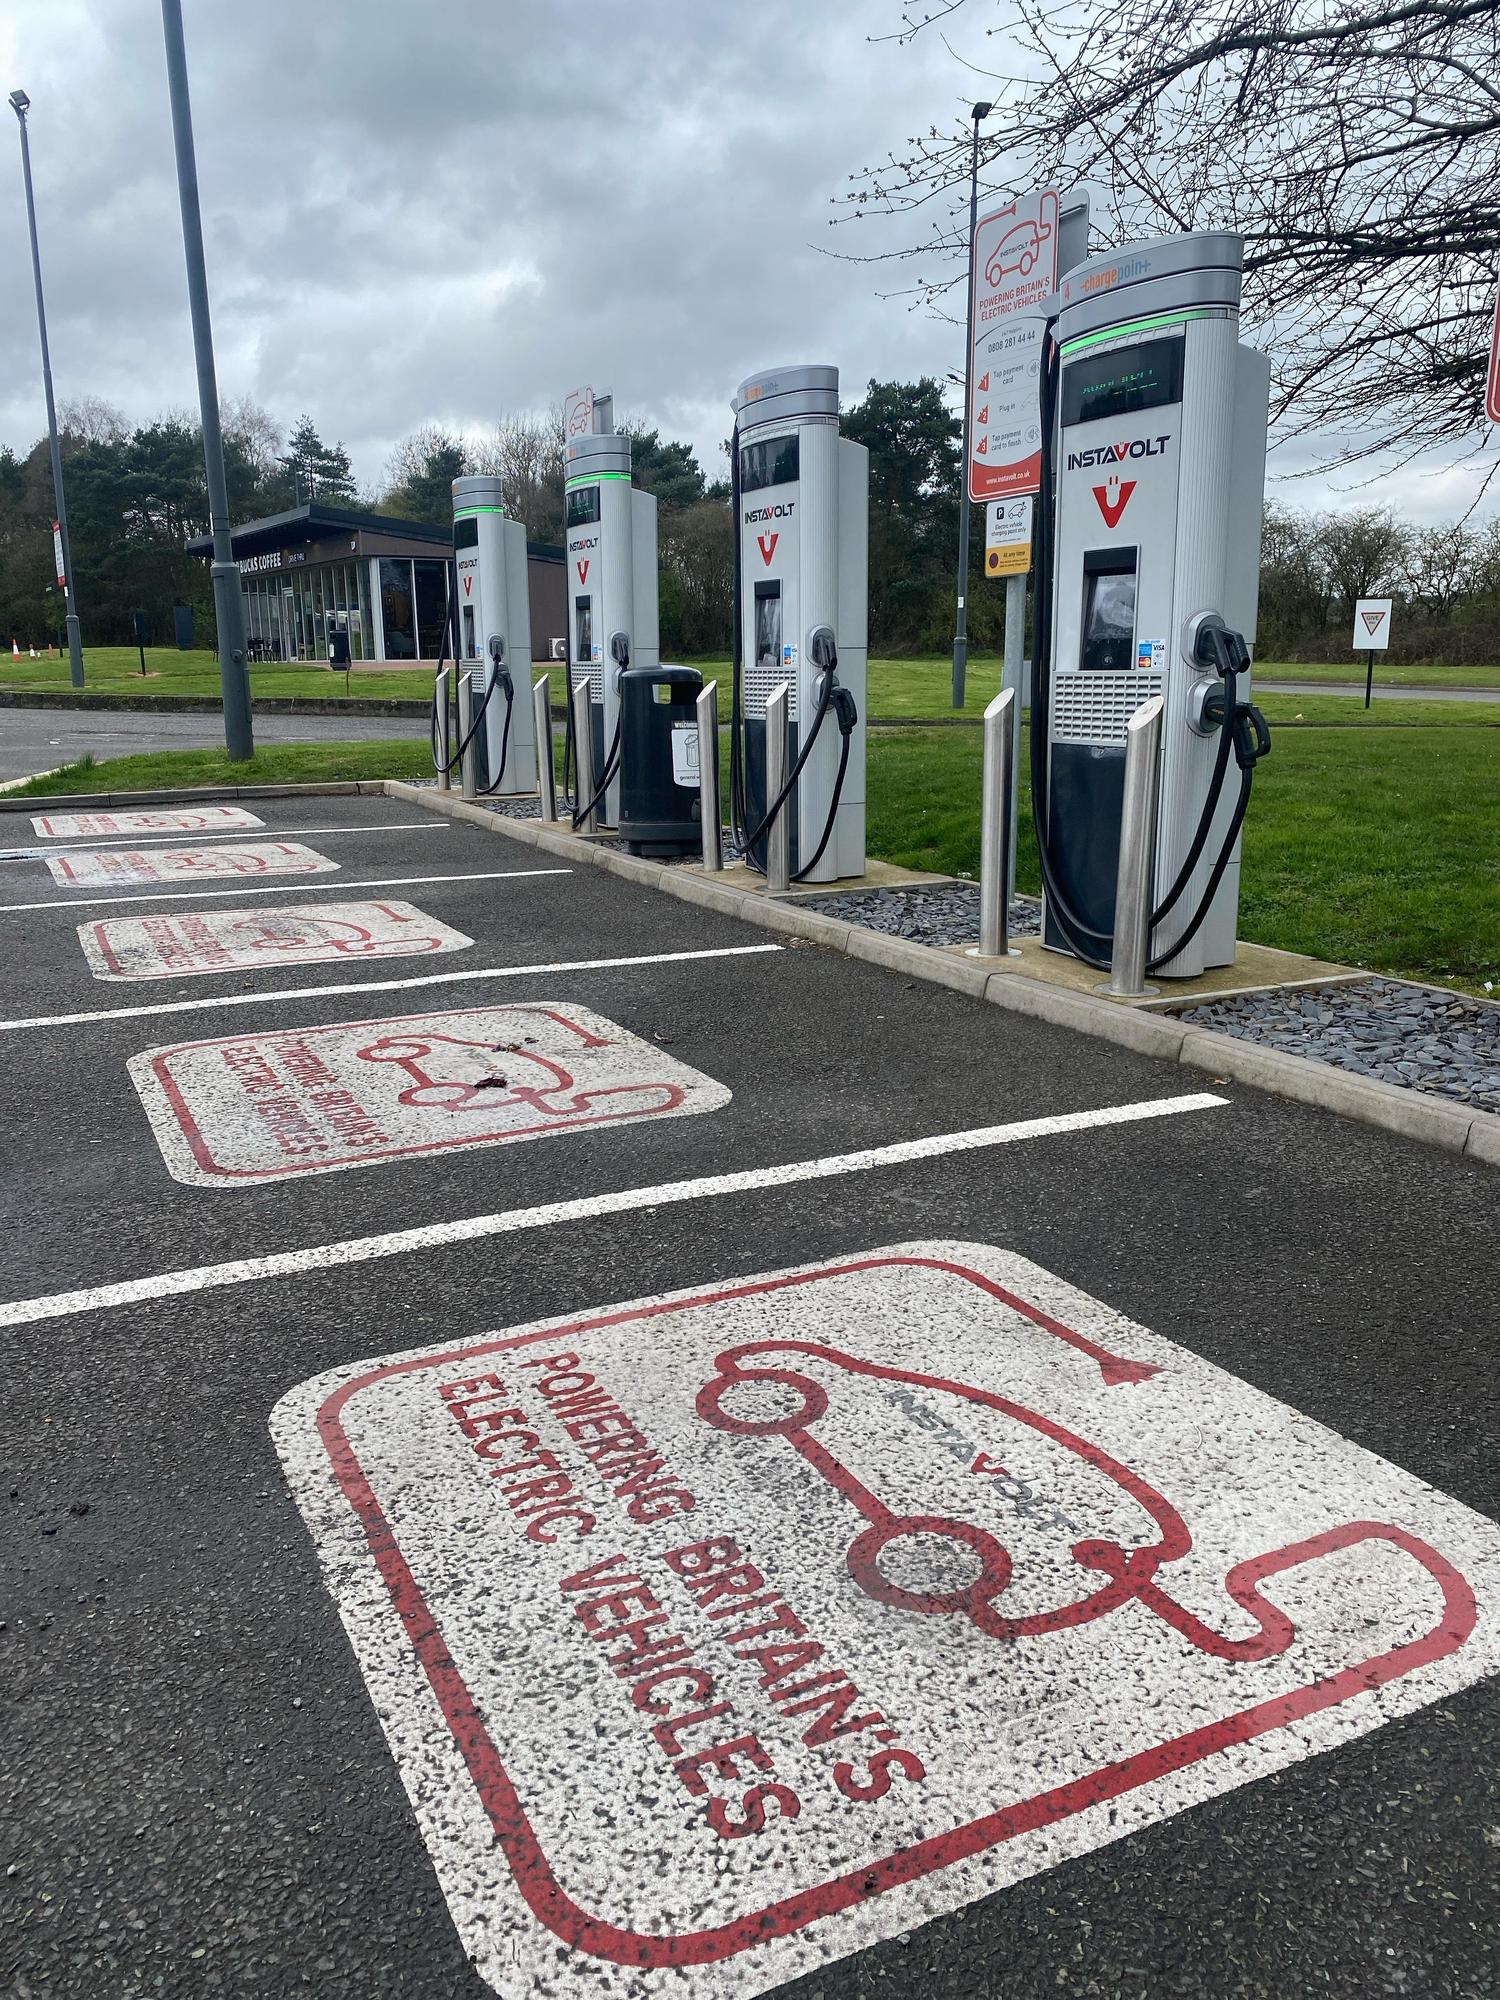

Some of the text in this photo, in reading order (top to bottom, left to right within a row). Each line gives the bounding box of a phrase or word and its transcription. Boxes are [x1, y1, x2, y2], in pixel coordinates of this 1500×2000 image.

[979, 289, 1015, 310] POWERING
[1016, 276, 1050, 297] BRITAIN'S
[981, 302, 1012, 321] ELECTRIC
[1013, 290, 1047, 312] VEHICLES
[1005, 336, 1016, 349] 281
[1018, 333, 1026, 343] 44
[1027, 329, 1035, 340] 44
[993, 365, 1024, 379] Tap payment
[1003, 376, 1014, 384] card
[1067, 435, 1171, 471] INSTAVOLT
[744, 503, 795, 524] INSTAVOLT
[259, 552, 282, 570] COFFEE
[220, 1045, 329, 1155] ELECTRIC VEHICLES
[265, 1038, 390, 1147] POWERING BRITAIN'S
[883, 1389, 1082, 1534] INSTAVOLT
[516, 1351, 927, 1802] POWERING BRITAIN'S
[436, 1373, 802, 1840] ELECTRIC VEHICLES
